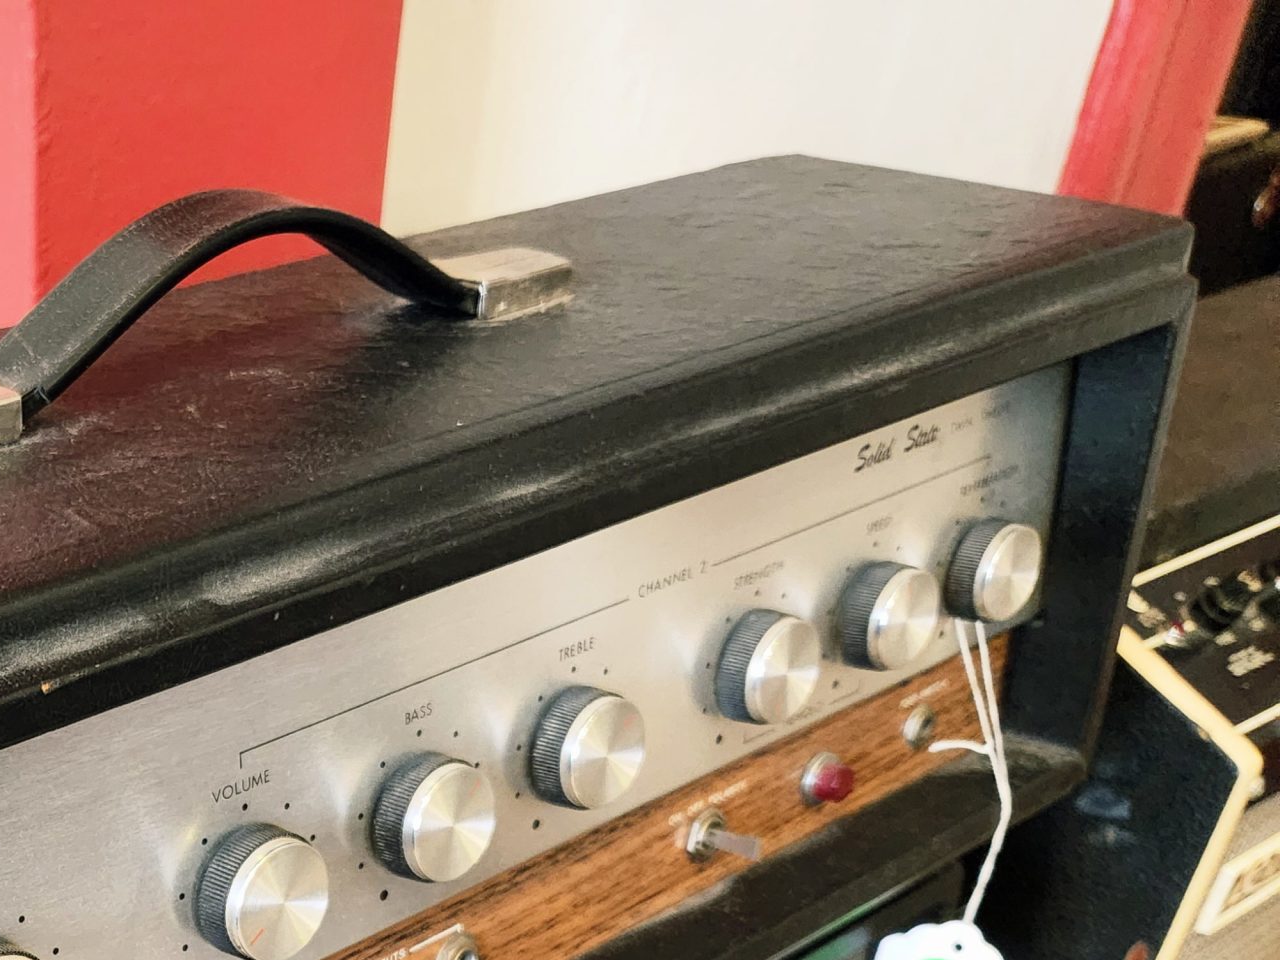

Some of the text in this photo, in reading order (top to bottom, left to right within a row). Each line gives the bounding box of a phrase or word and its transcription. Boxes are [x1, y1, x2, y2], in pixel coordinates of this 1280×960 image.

[852, 437, 896, 473] Solid
[638, 559, 709, 599] CHANNEL 2
[557, 636, 597, 662] TREBLE
[403, 702, 434, 726] BASS
[211, 768, 272, 804] VOLUME
